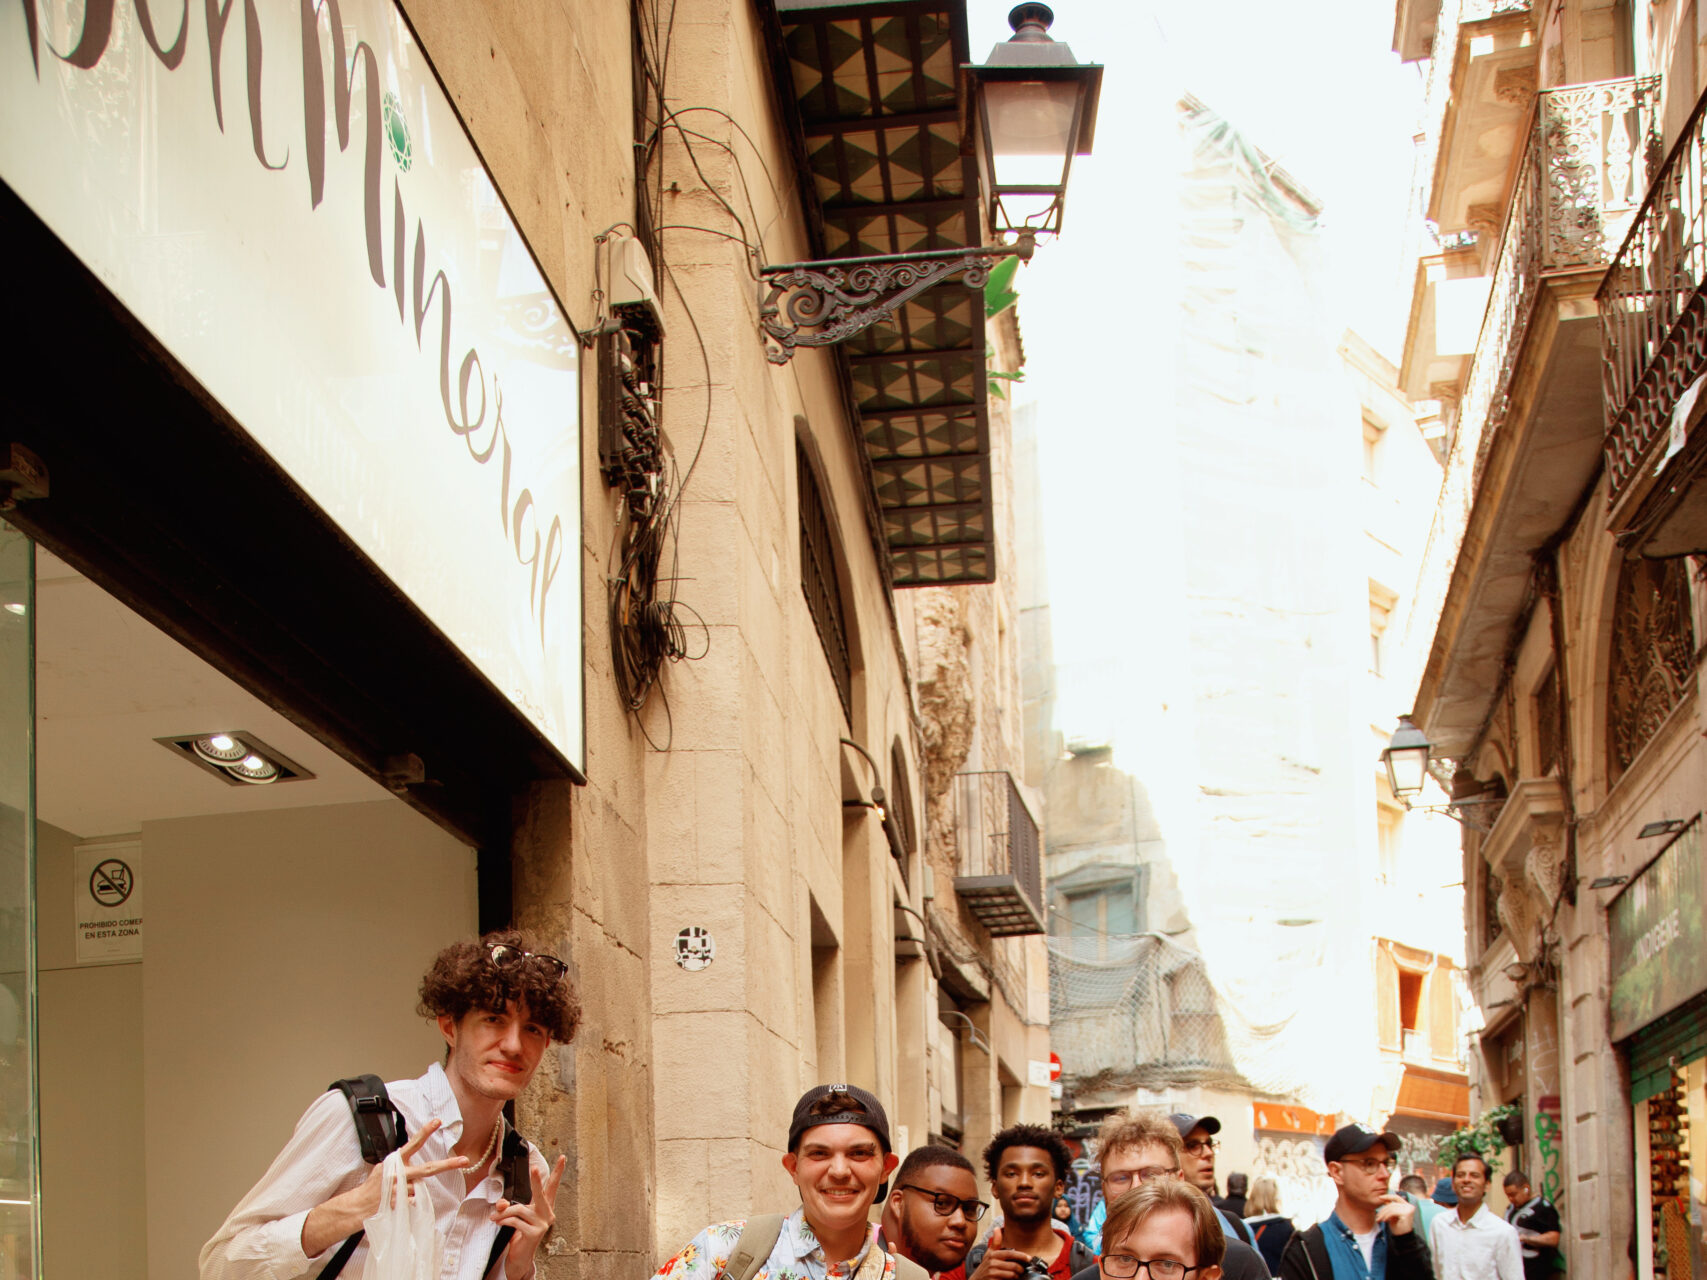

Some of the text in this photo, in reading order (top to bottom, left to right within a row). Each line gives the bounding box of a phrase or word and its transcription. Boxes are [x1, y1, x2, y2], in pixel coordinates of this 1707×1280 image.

[80, 920, 118, 930] PROHIBIDO
[85, 928, 140, 939] EN ESTA ZONA
